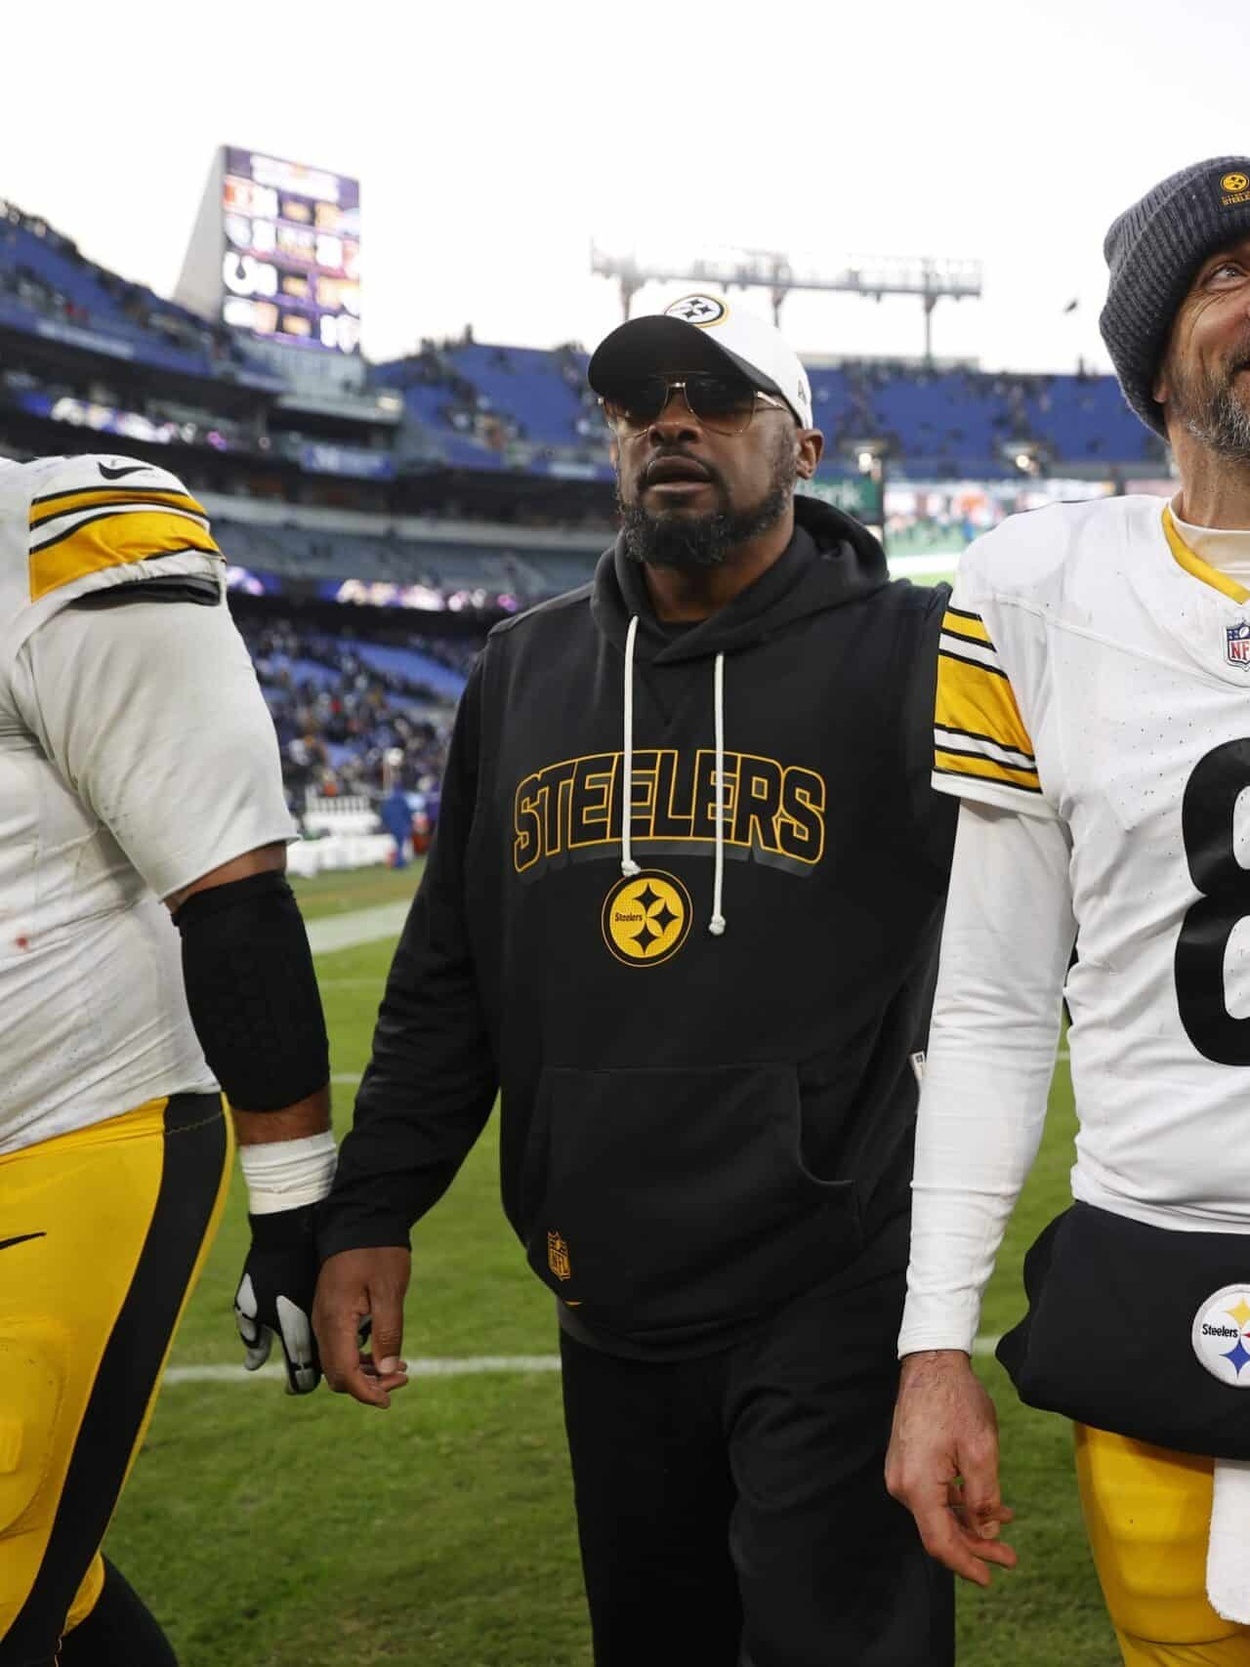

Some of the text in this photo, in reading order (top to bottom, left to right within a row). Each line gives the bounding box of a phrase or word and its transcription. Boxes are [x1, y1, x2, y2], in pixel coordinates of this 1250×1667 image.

[514, 749, 826, 873] STEELERS
[615, 911, 643, 922] Steelers
[1202, 1323, 1239, 1338] Steelers
